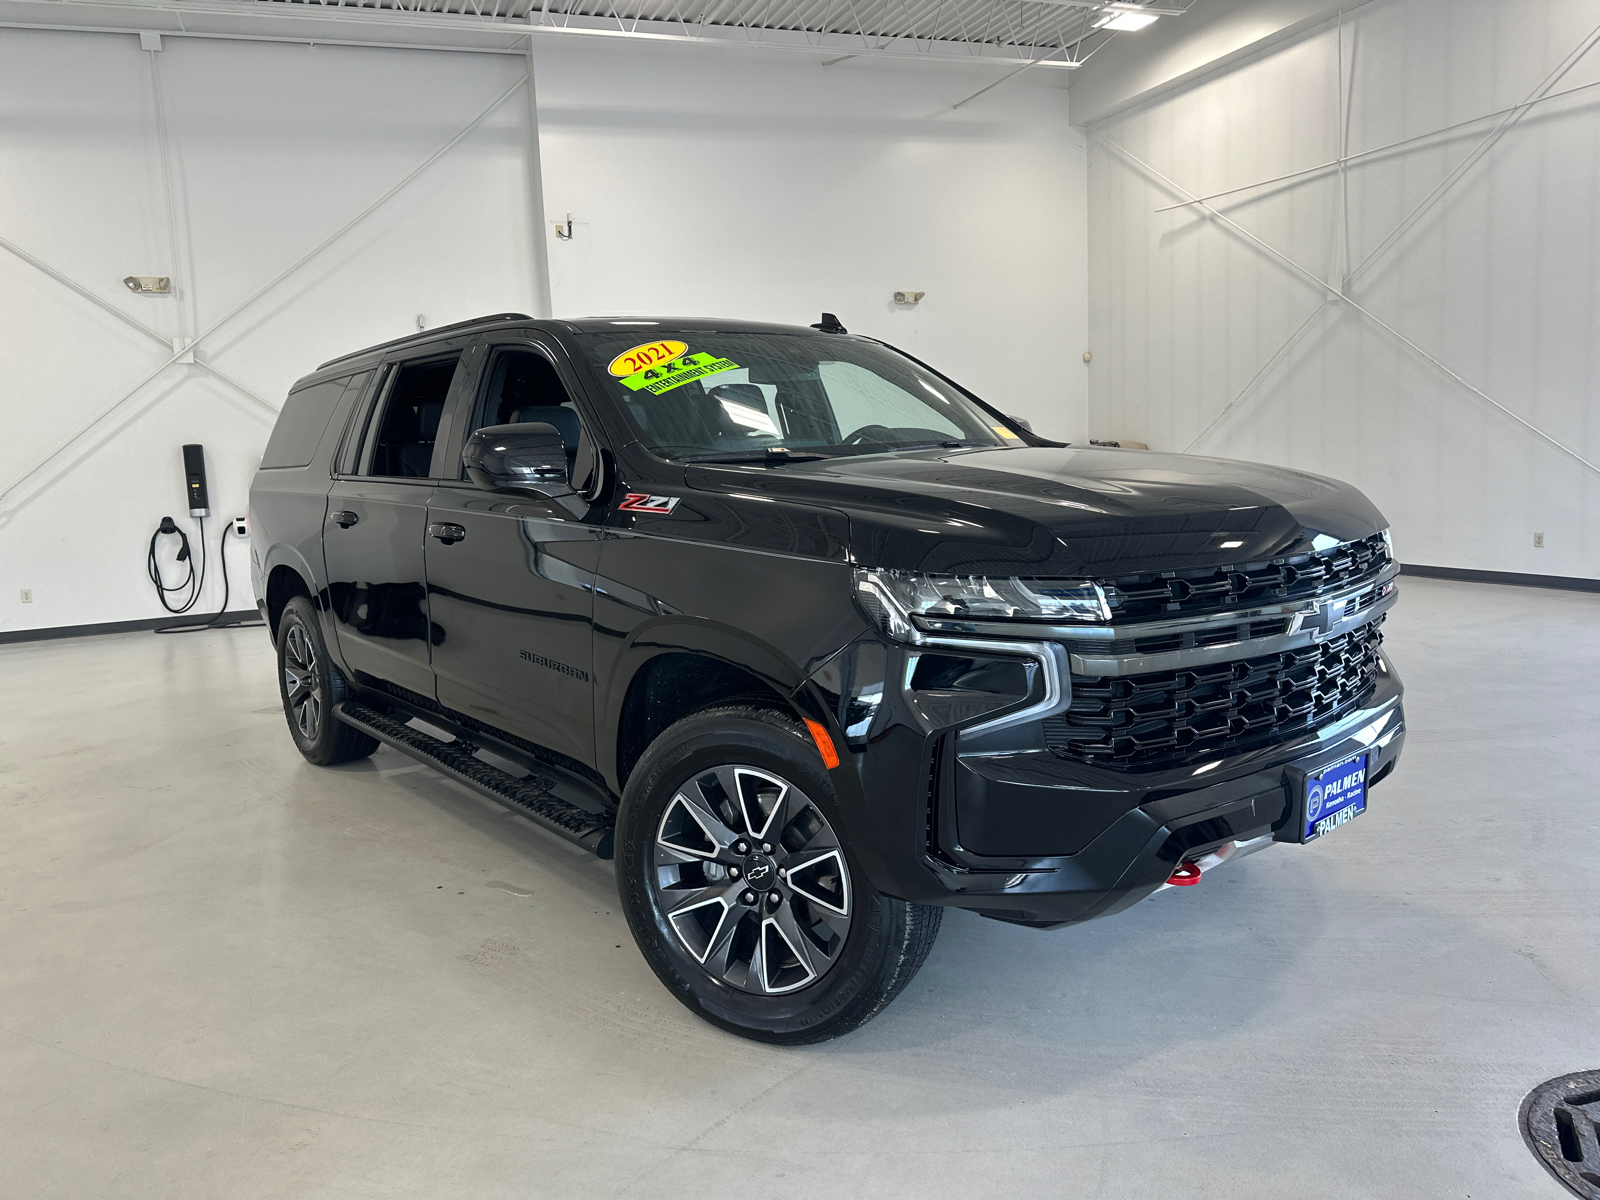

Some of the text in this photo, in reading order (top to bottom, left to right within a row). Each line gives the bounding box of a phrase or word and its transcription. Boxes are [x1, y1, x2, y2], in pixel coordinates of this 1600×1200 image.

[624, 343, 675, 372] 2021
[645, 359, 737, 393] ENTERTAINMENT SYSTEM
[617, 493, 681, 514] Z71
[519, 649, 589, 682] SUBURBAN
[1324, 768, 1366, 800] PALMEN
[1326, 788, 1361, 809] Kenosha Racine
[1320, 805, 1354, 836] PALMEN
